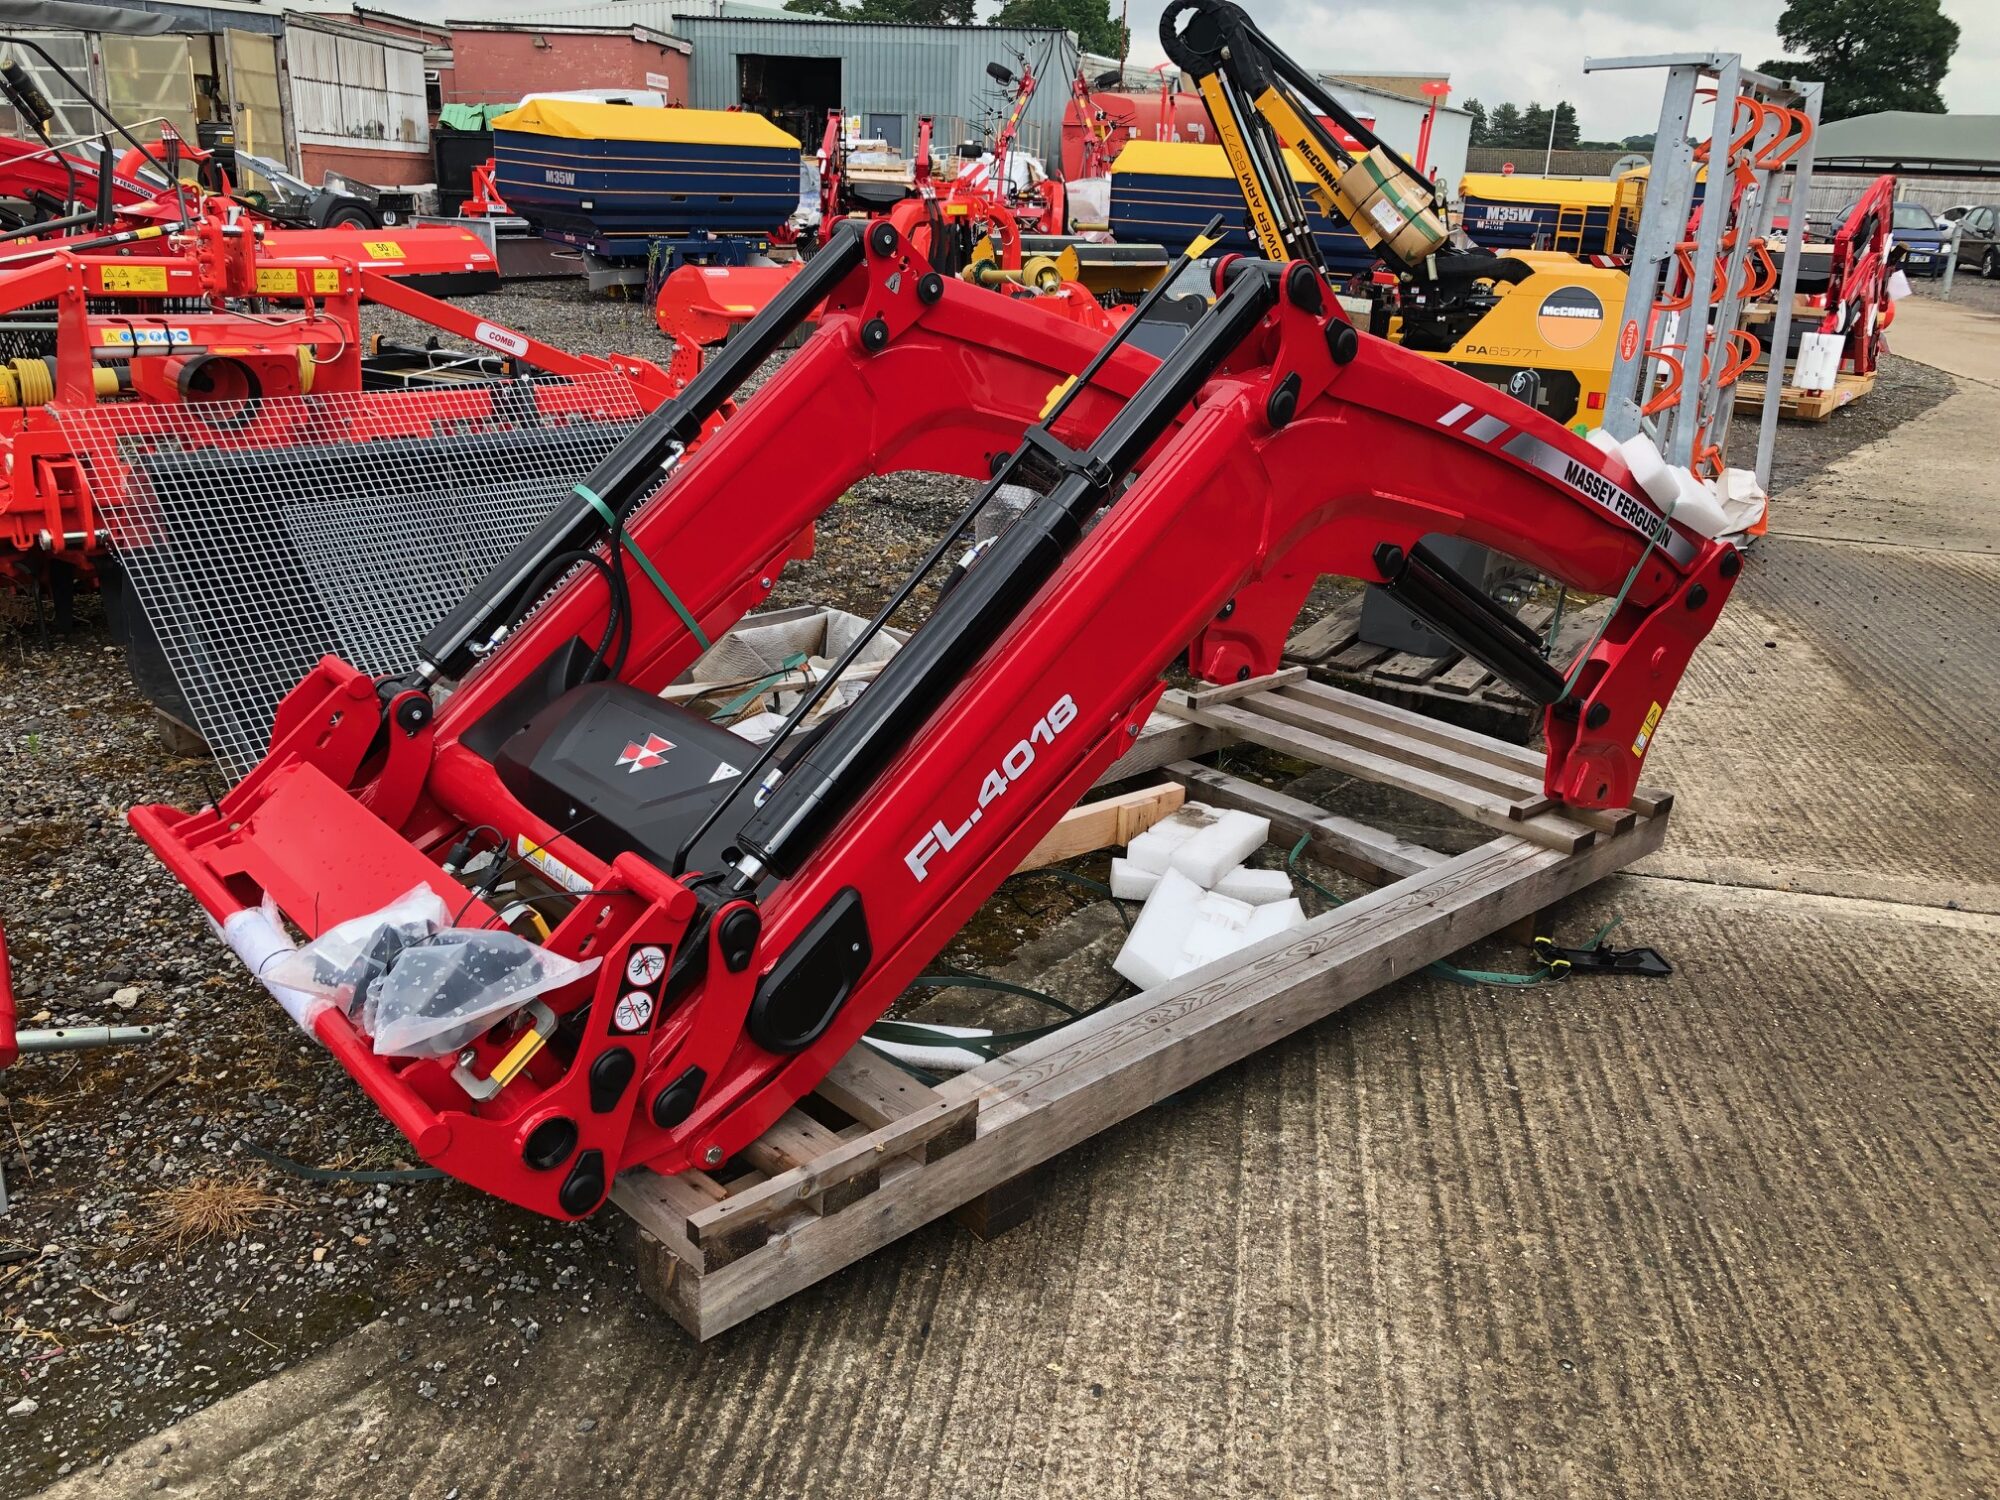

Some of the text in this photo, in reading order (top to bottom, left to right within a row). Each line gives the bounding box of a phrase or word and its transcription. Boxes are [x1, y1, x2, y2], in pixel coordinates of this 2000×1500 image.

[1296, 138, 1342, 197] McCONNEL
[545, 169, 575, 186] M35W
[119, 180, 153, 199] FERGUSON
[1221, 124, 1282, 261] OWER ARM 6577T
[385, 211, 394, 223] 40
[1485, 206, 1535, 222] M35W
[375, 243, 389, 252] 50
[1542, 305, 1600, 319] McCONNEL
[489, 331, 516, 348] COMBI
[1623, 322, 1637, 359] RITCHIE
[1465, 344, 1542, 360] PA6577T
[1564, 460, 1617, 507] MASSEY
[903, 693, 1079, 884] FL.4018
